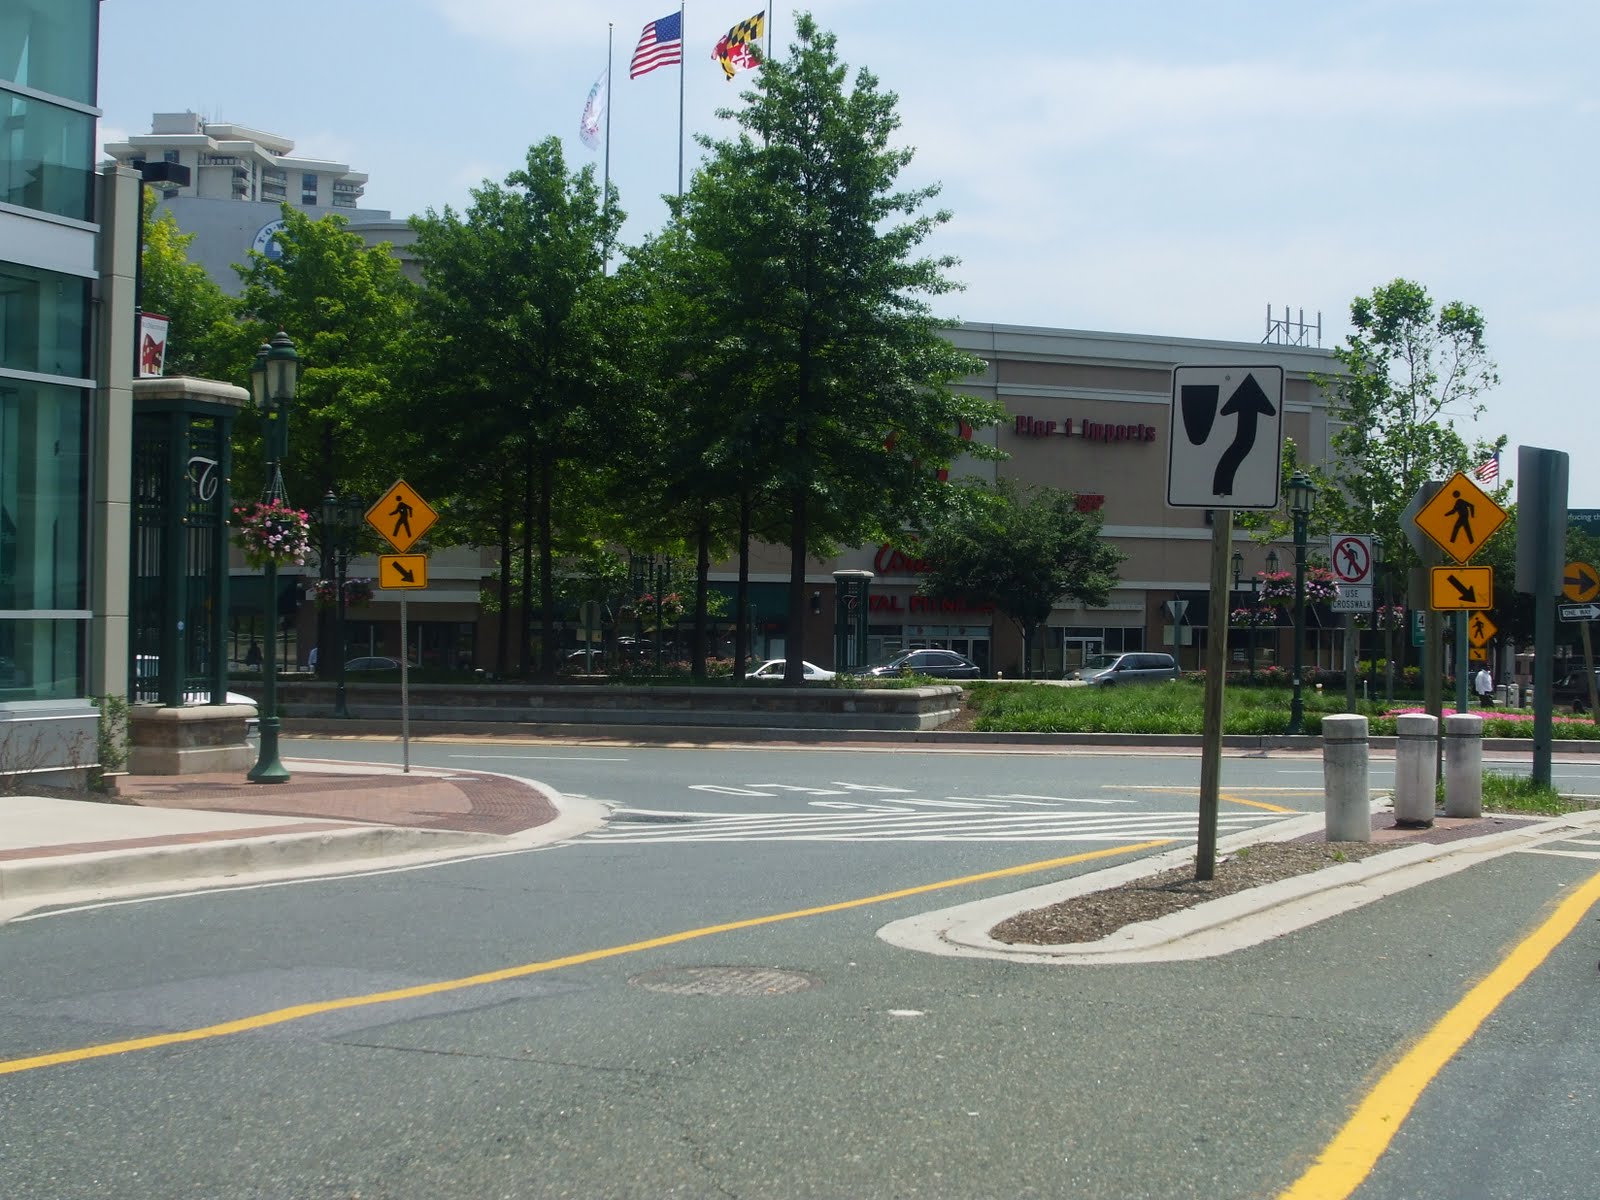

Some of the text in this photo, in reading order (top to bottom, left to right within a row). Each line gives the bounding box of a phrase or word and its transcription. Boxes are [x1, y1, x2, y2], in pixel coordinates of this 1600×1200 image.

[1015, 415, 1156, 443] Pier 1 Imports
[1345, 589, 1359, 598] USE
[1332, 599, 1372, 609] CROSSWALK
